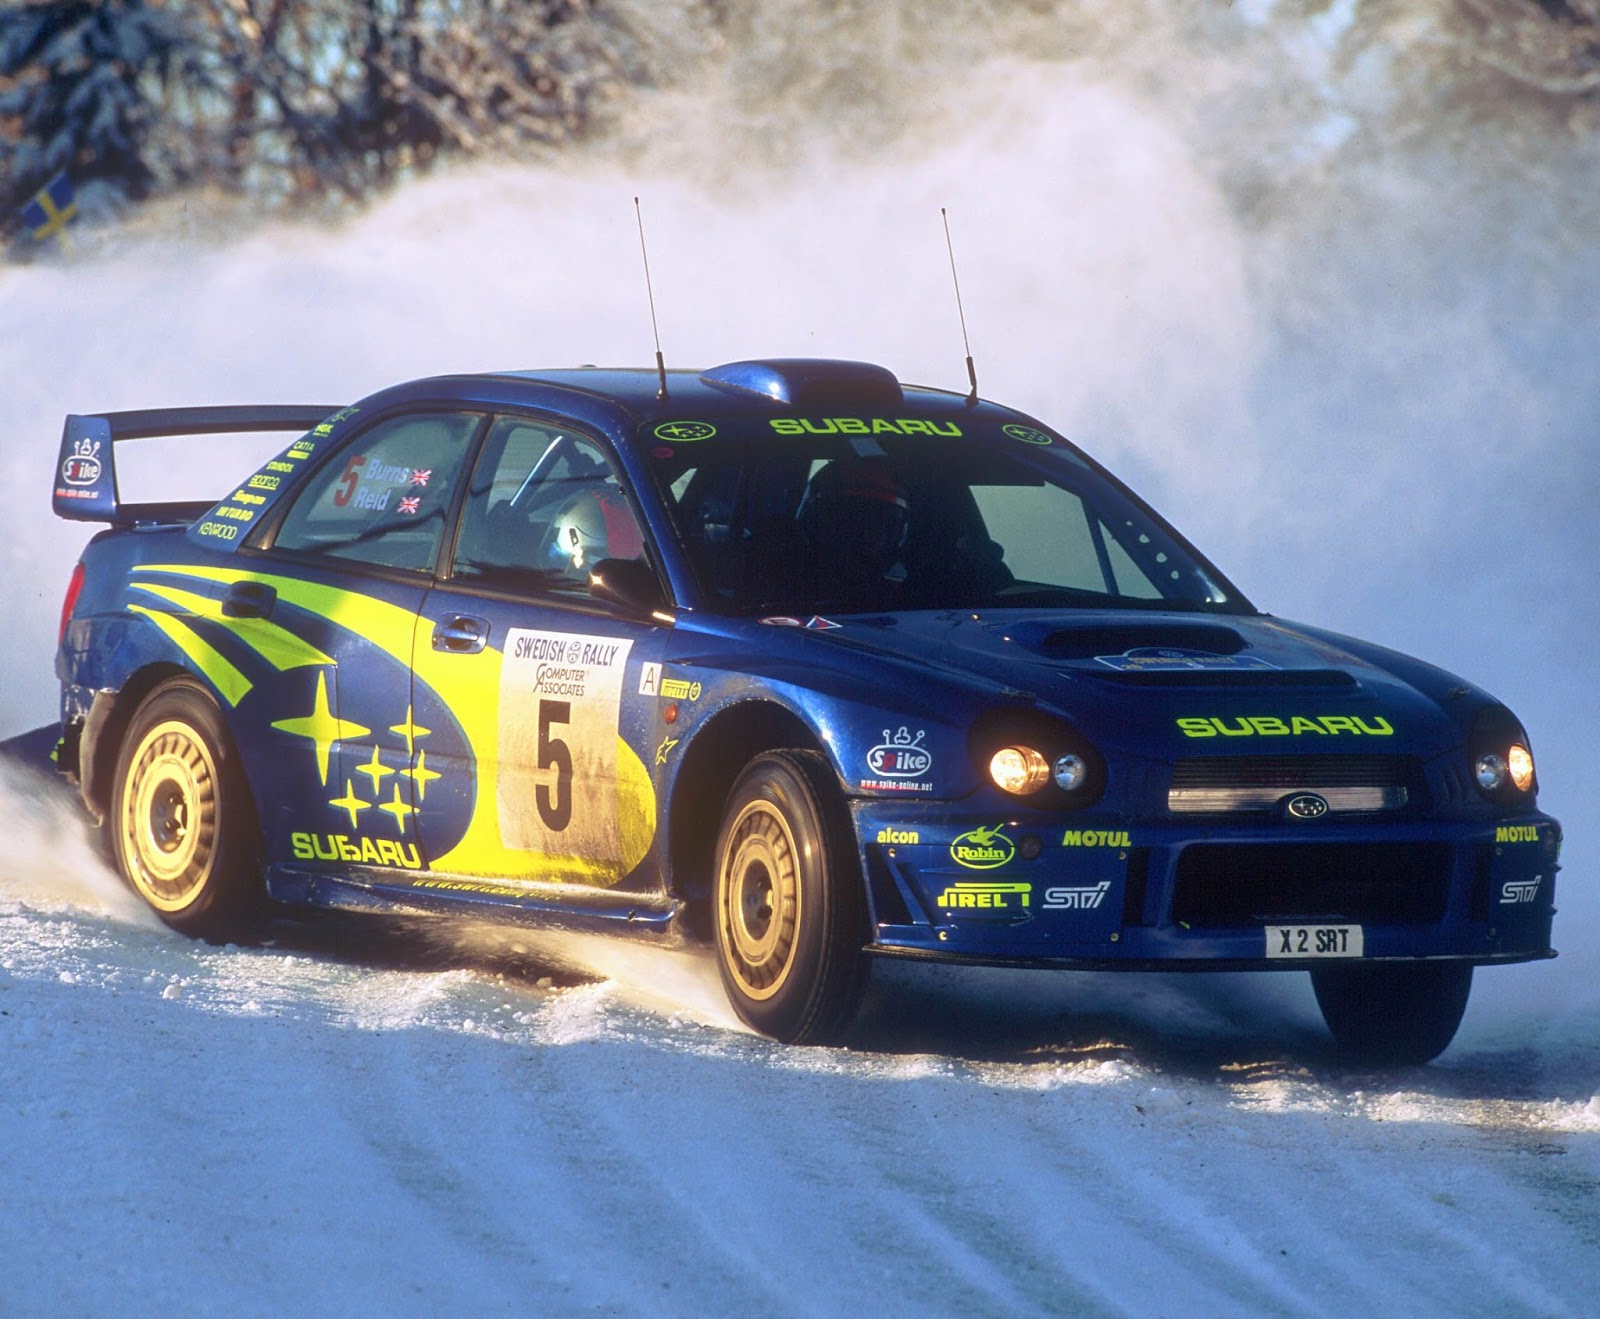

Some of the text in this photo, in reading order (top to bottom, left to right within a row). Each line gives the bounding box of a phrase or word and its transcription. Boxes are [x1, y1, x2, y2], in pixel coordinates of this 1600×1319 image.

[769, 418, 963, 437] SUBARU
[66, 461, 98, 480] Spike
[334, 455, 410, 507] 5 Burns
[354, 487, 391, 511] Reid
[198, 522, 238, 540] KENWOOD
[514, 637, 619, 666] SWEDISH RALLY
[536, 663, 585, 682] COMPUTER
[643, 666, 655, 692] A
[533, 681, 585, 696] ASSOCIATES
[660, 679, 691, 699] PIRELLI
[1176, 716, 1394, 738] SUBARU
[535, 699, 573, 832] 5
[872, 750, 927, 773] Spike
[877, 827, 919, 844] alcon
[1062, 830, 1132, 847] MOTUL
[1496, 826, 1539, 842] MOTUL
[291, 832, 421, 869] SUBARU
[957, 846, 1006, 860] Robin
[937, 882, 1032, 908] PIRELI
[1280, 929, 1349, 953] X 2 SRT
